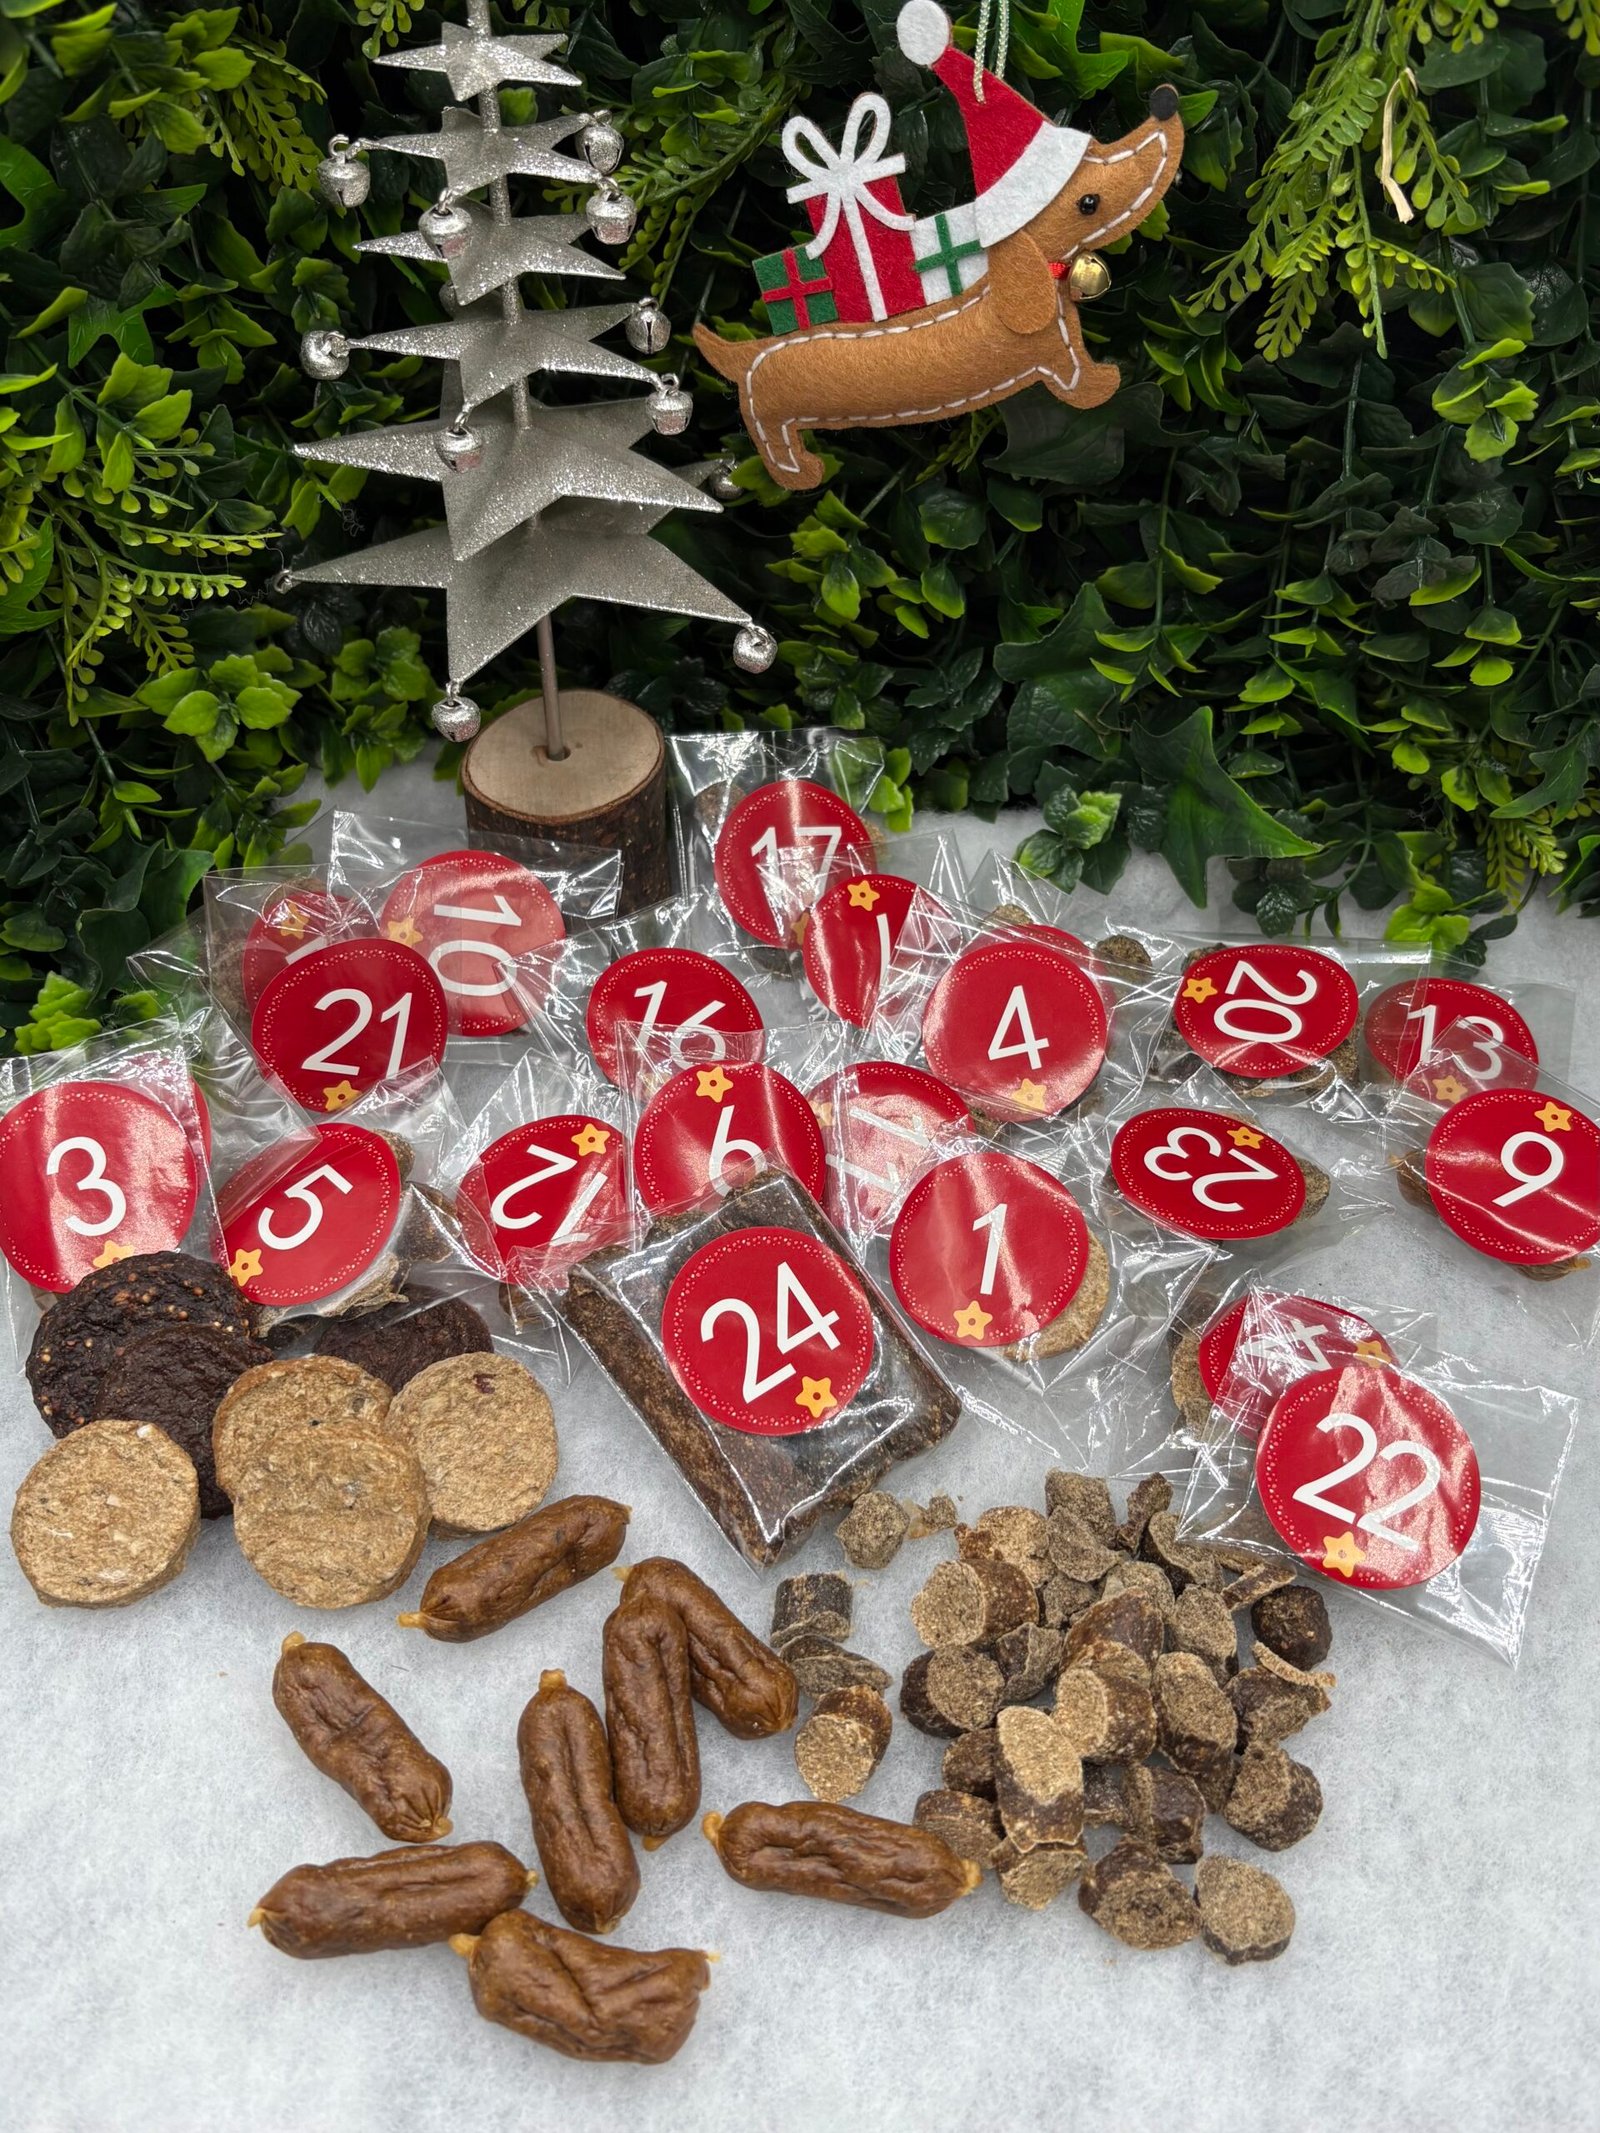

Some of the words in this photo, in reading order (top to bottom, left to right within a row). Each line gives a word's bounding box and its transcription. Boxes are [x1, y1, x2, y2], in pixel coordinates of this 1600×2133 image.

[751, 826, 842, 905] 17
[428, 895, 522, 997] 10
[301, 988, 413, 1079] 21
[634, 980, 726, 1070] 16
[987, 985, 1050, 1070] 4
[1213, 960, 1318, 1043] 20
[1406, 1004, 1503, 1080] 13
[46, 1136, 127, 1237] 3
[257, 1163, 354, 1250] 5
[1143, 1127, 1279, 1212] 23
[972, 1203, 1008, 1295] 1
[700, 1261, 841, 1404] 24
[1292, 1413, 1441, 1551] 22
